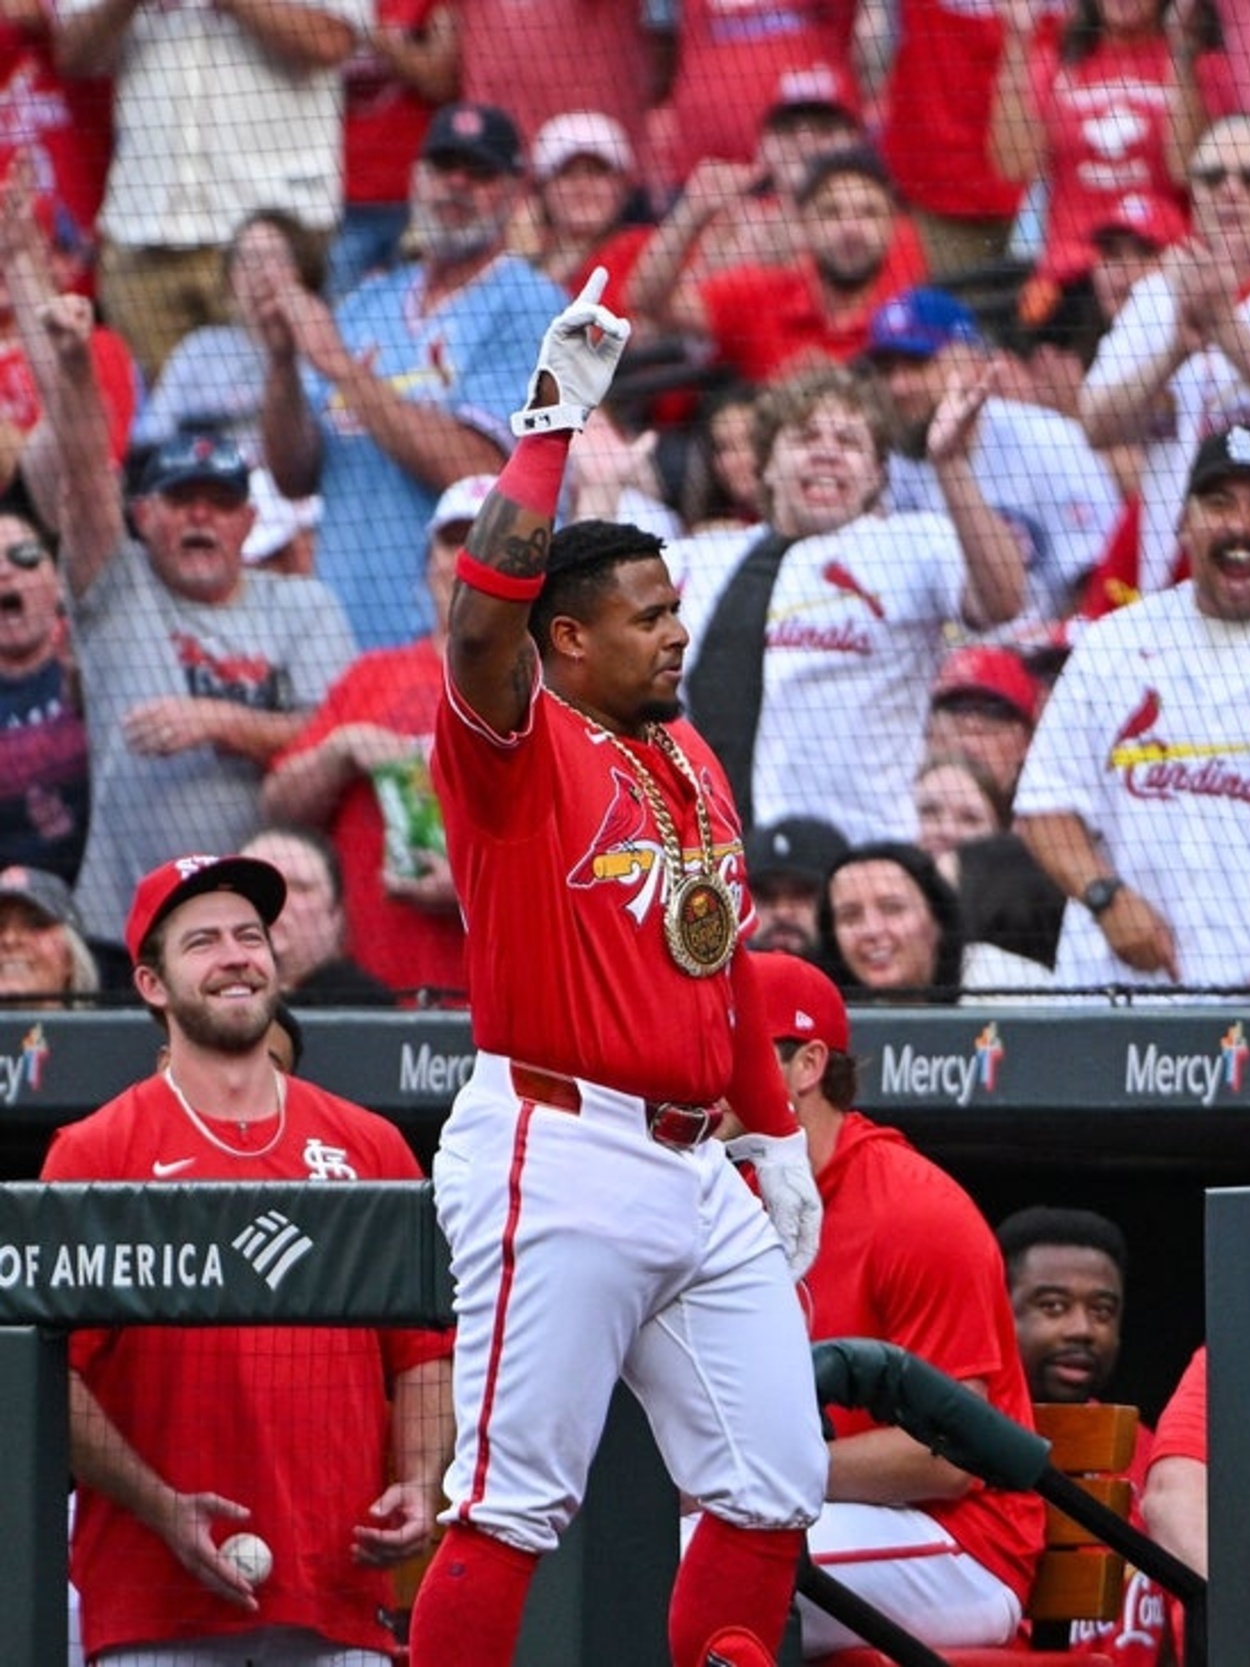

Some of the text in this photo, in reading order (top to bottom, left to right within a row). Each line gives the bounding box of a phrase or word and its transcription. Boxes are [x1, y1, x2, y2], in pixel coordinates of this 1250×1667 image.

[400, 1042, 475, 1092] Merc
[881, 1043, 977, 1105] Mercy
[1125, 1042, 1222, 1105] Mercy
[0, 1243, 224, 1289] OF AMERICA
